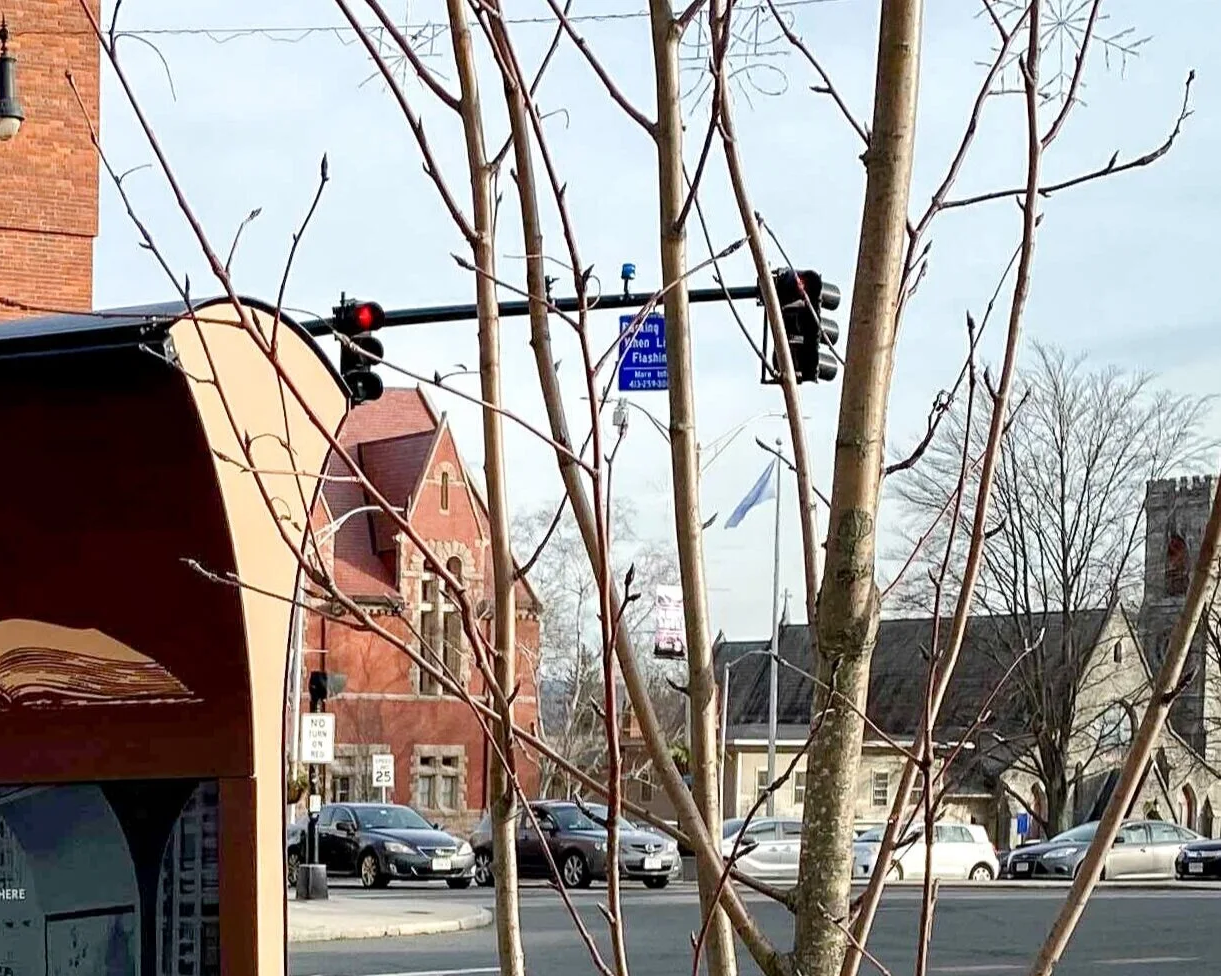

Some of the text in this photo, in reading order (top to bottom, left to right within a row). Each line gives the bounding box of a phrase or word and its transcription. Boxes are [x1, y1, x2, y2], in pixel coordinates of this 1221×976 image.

[632, 351, 668, 364] Flashin
[311, 719, 326, 728] NO
[312, 740, 324, 749] ON
[376, 770, 392, 783] 25
